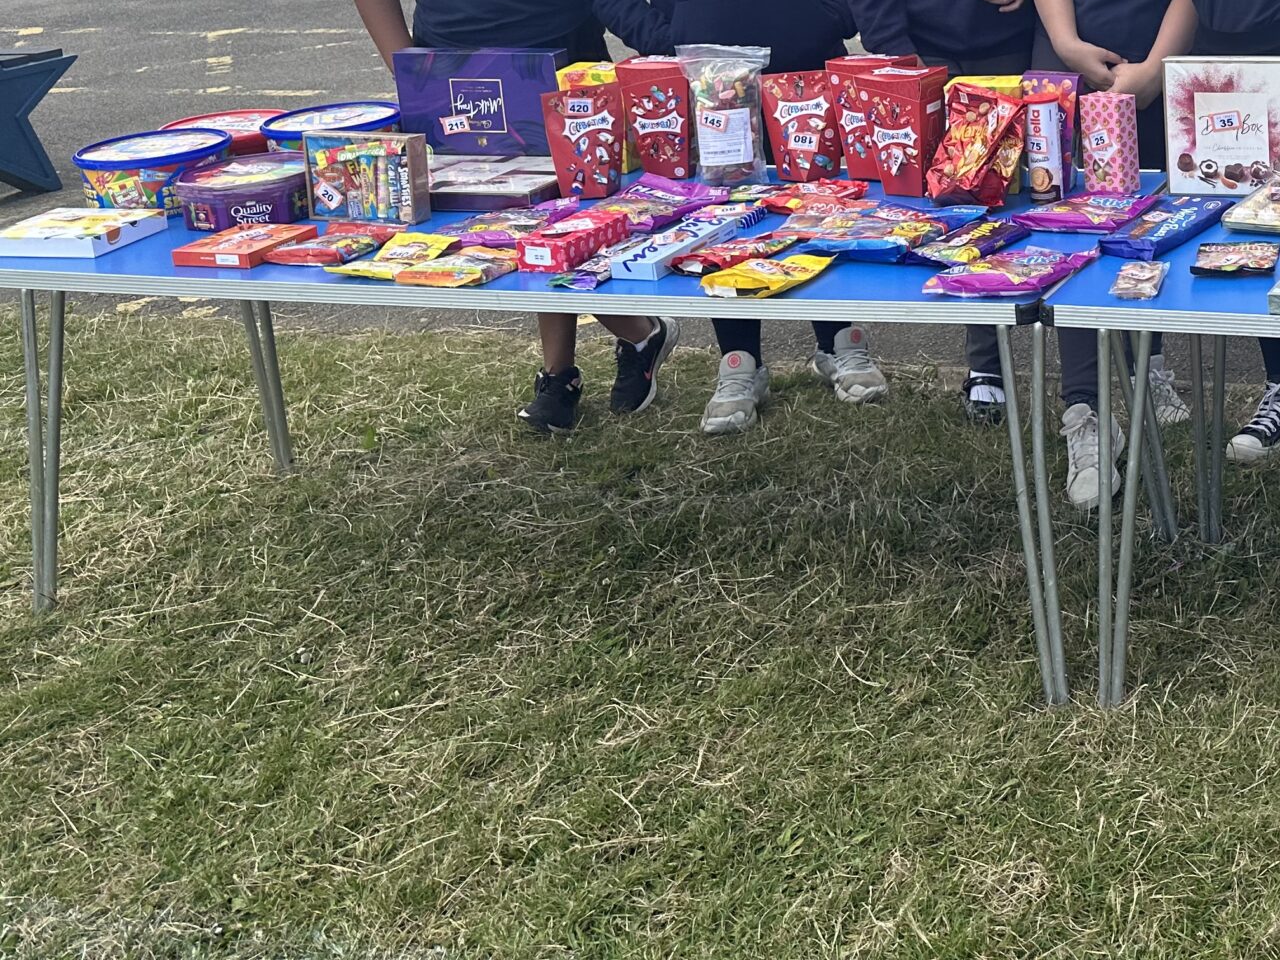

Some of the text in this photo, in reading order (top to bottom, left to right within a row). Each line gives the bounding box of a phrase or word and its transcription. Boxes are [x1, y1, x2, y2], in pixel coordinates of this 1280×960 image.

[569, 105, 589, 113] 420
[448, 121, 466, 131] 215
[703, 116, 722, 128] 145
[1219, 118, 1234, 128] 35
[793, 135, 814, 145] 180
[1094, 136, 1106, 145] 25
[1030, 141, 1042, 151] 75
[322, 190, 334, 202] 20
[230, 202, 273, 218] Quality
[236, 214, 270, 225] Street
